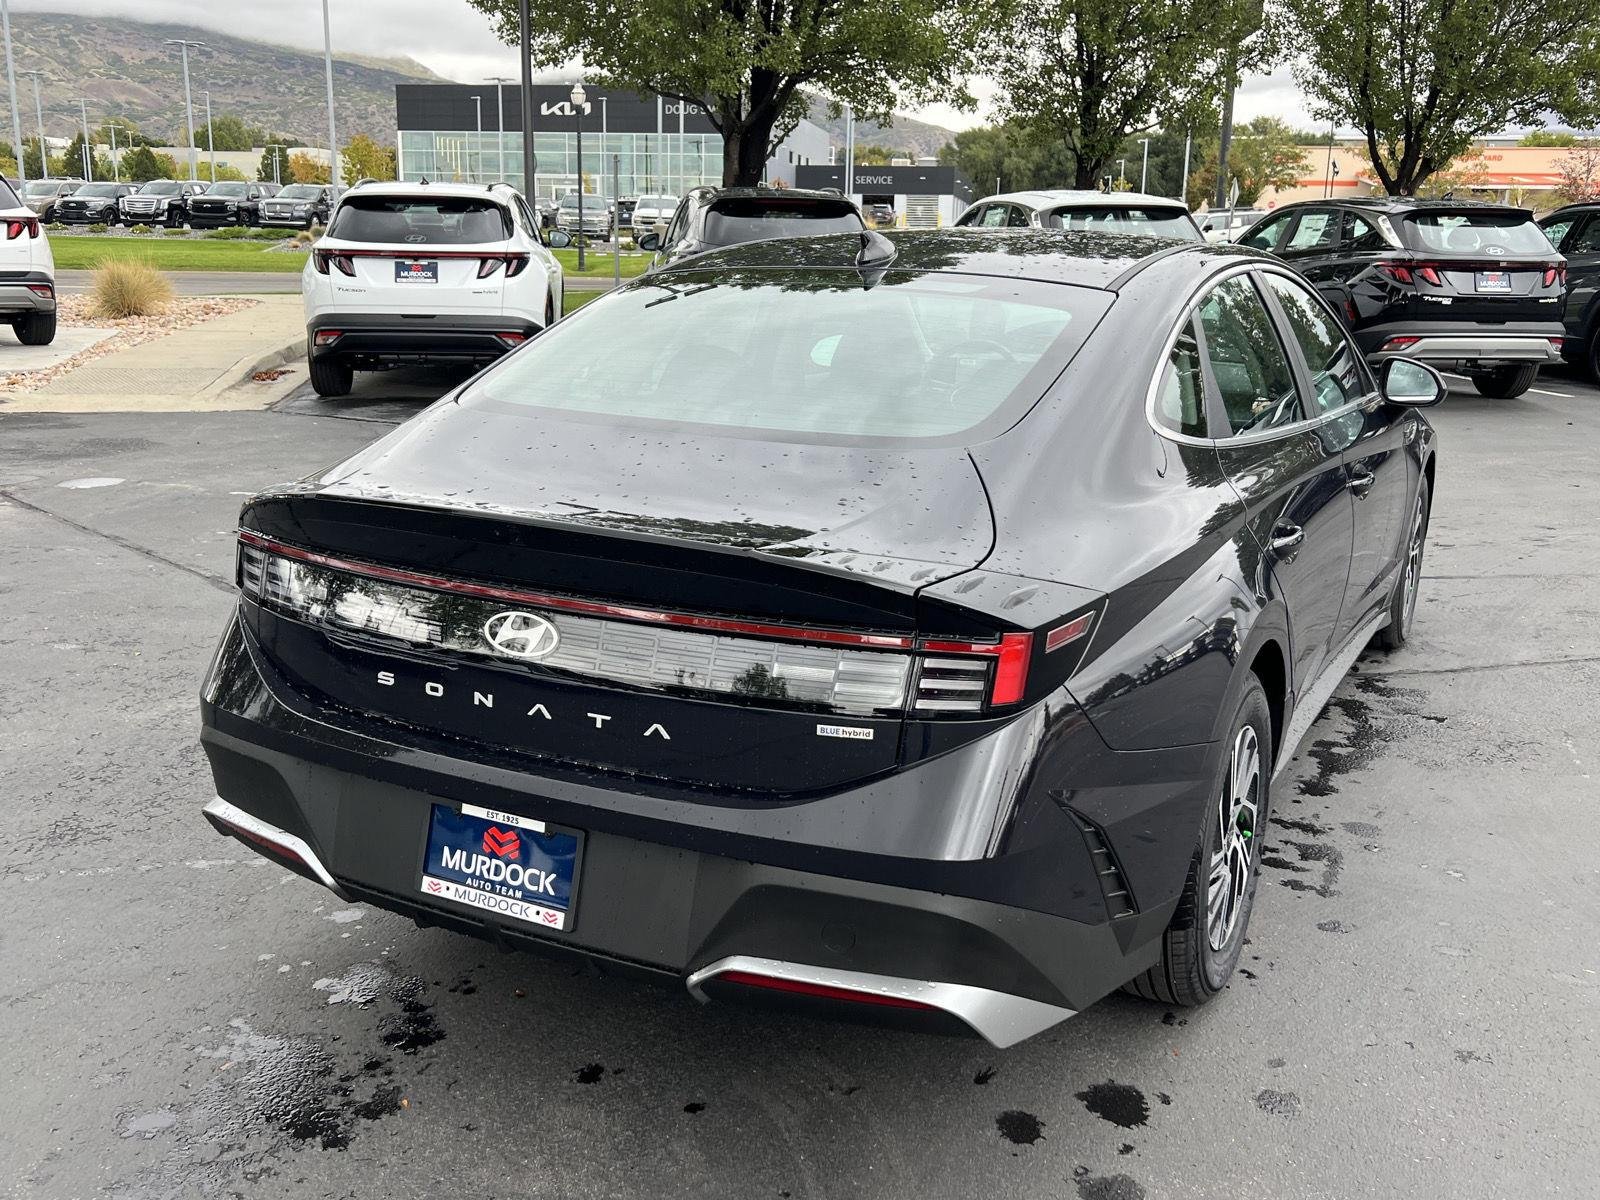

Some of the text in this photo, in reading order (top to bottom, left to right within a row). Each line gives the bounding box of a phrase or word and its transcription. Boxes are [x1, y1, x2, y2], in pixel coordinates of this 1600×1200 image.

[665, 104, 698, 115] DOUG
[855, 175, 893, 185] SERVICE
[377, 670, 671, 740] SONATA
[820, 726, 871, 738] BLUE hybrid
[502, 814, 520, 825] 1925
[441, 845, 557, 896] MURDOCK
[465, 877, 523, 899] AUTO TEAM
[453, 887, 531, 918] MURDOCK
